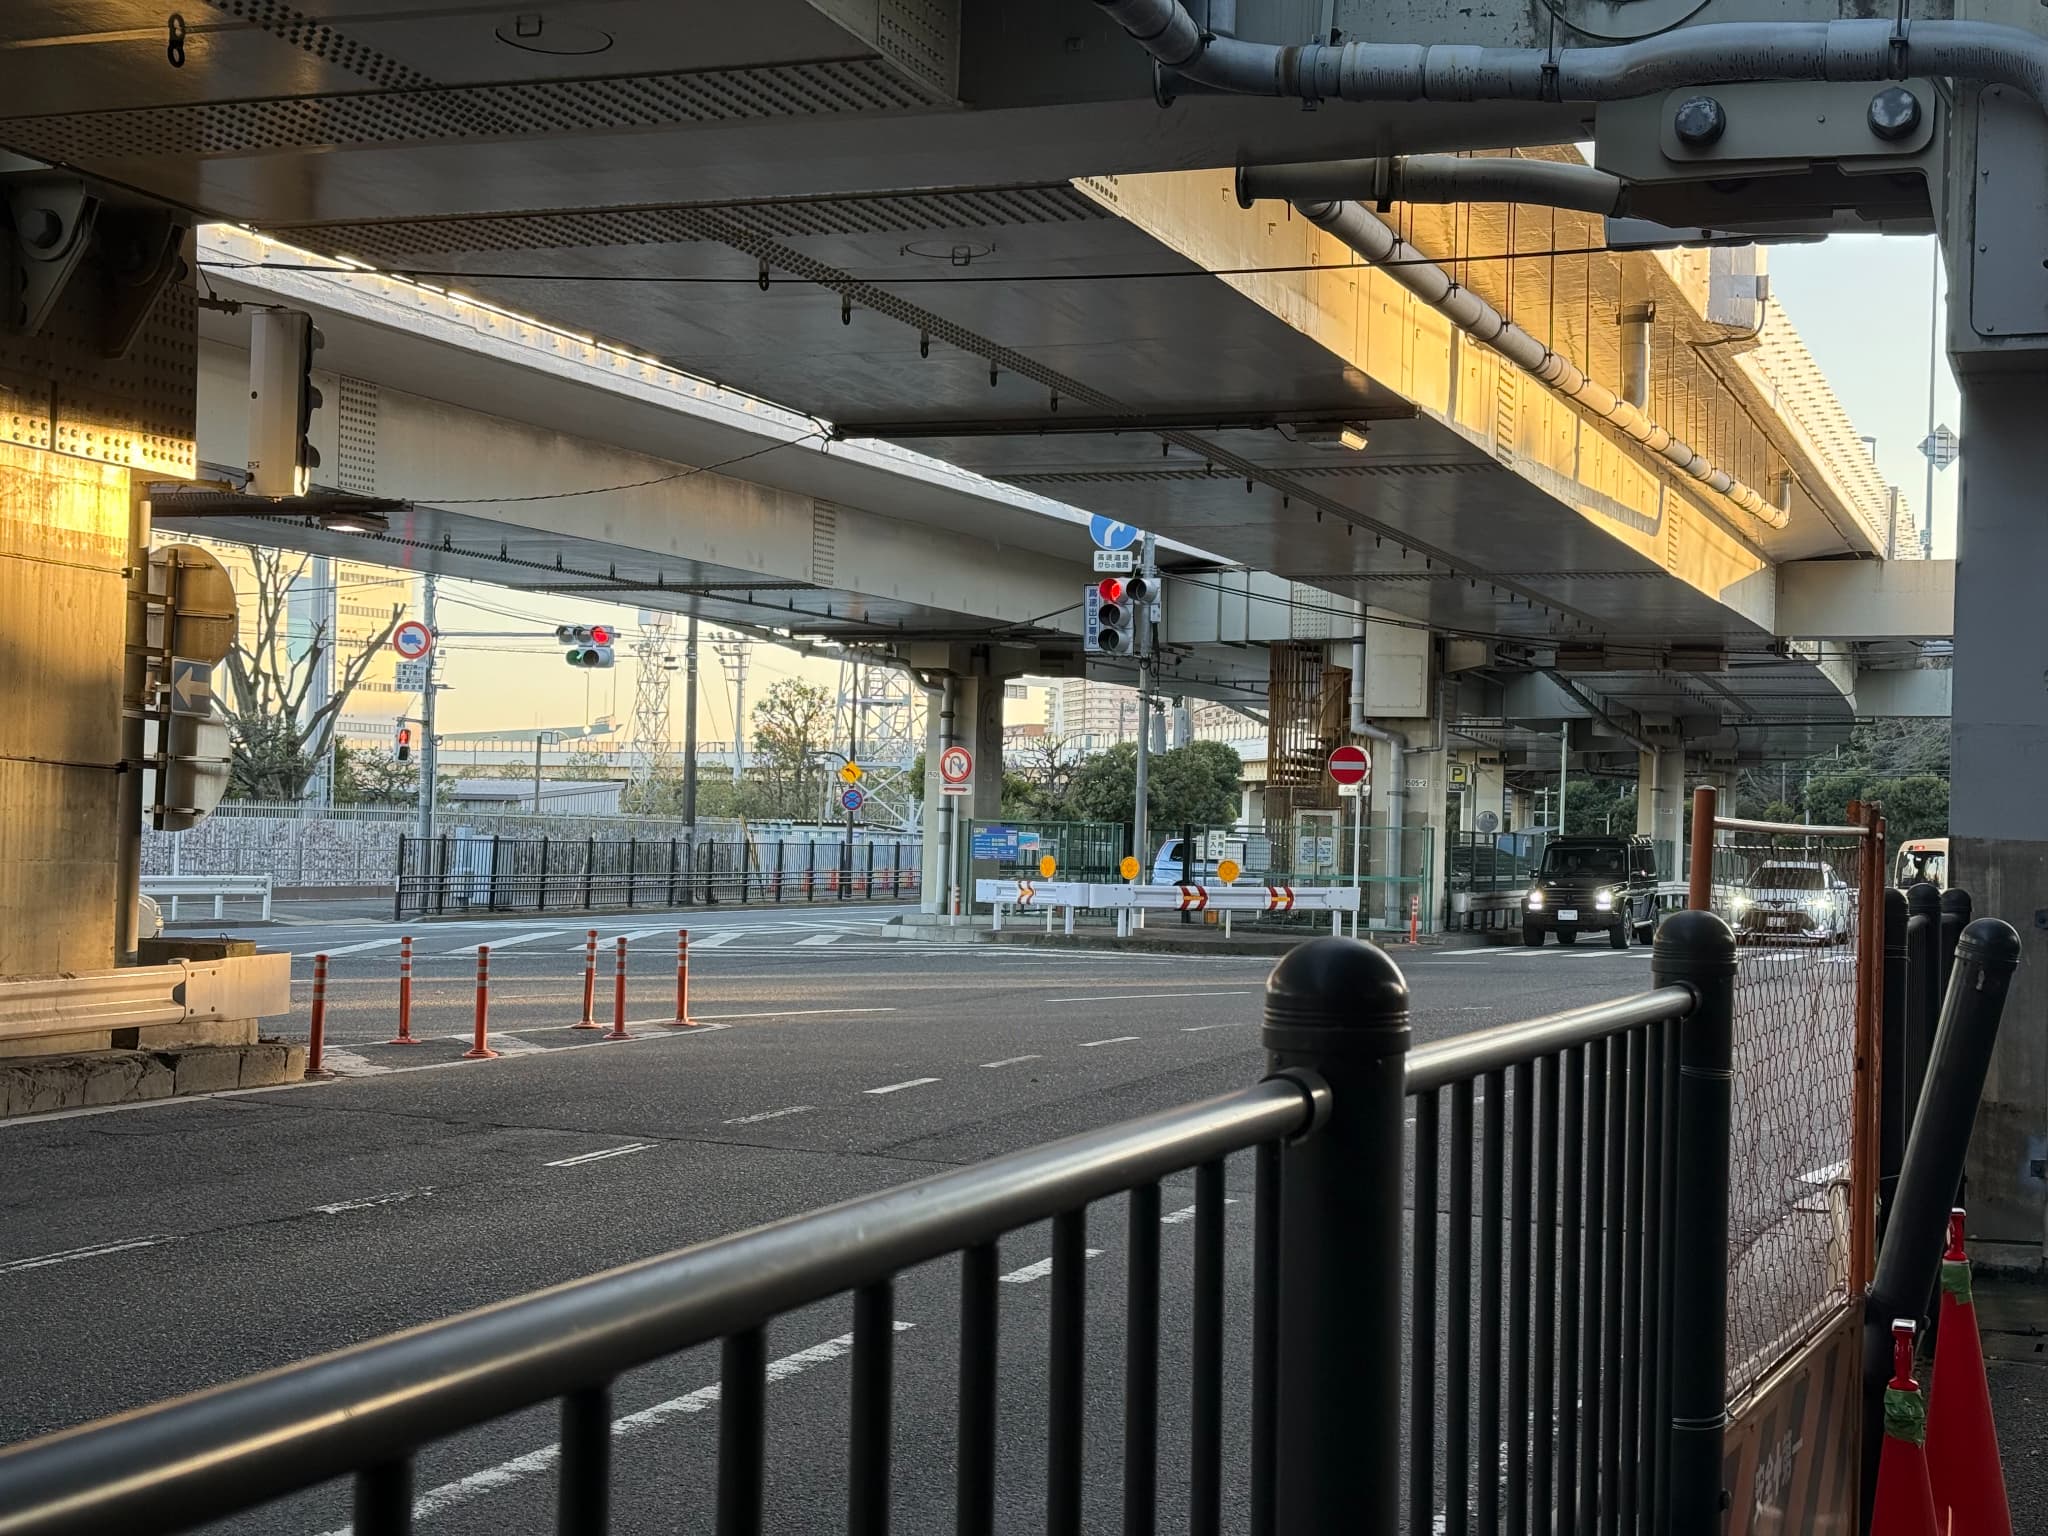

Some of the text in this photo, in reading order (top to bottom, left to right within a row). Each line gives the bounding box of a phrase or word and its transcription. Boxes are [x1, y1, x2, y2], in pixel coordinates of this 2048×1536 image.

[1088, 588, 1098, 645] 高速出口専用
[1452, 768, 1463, 782] P
